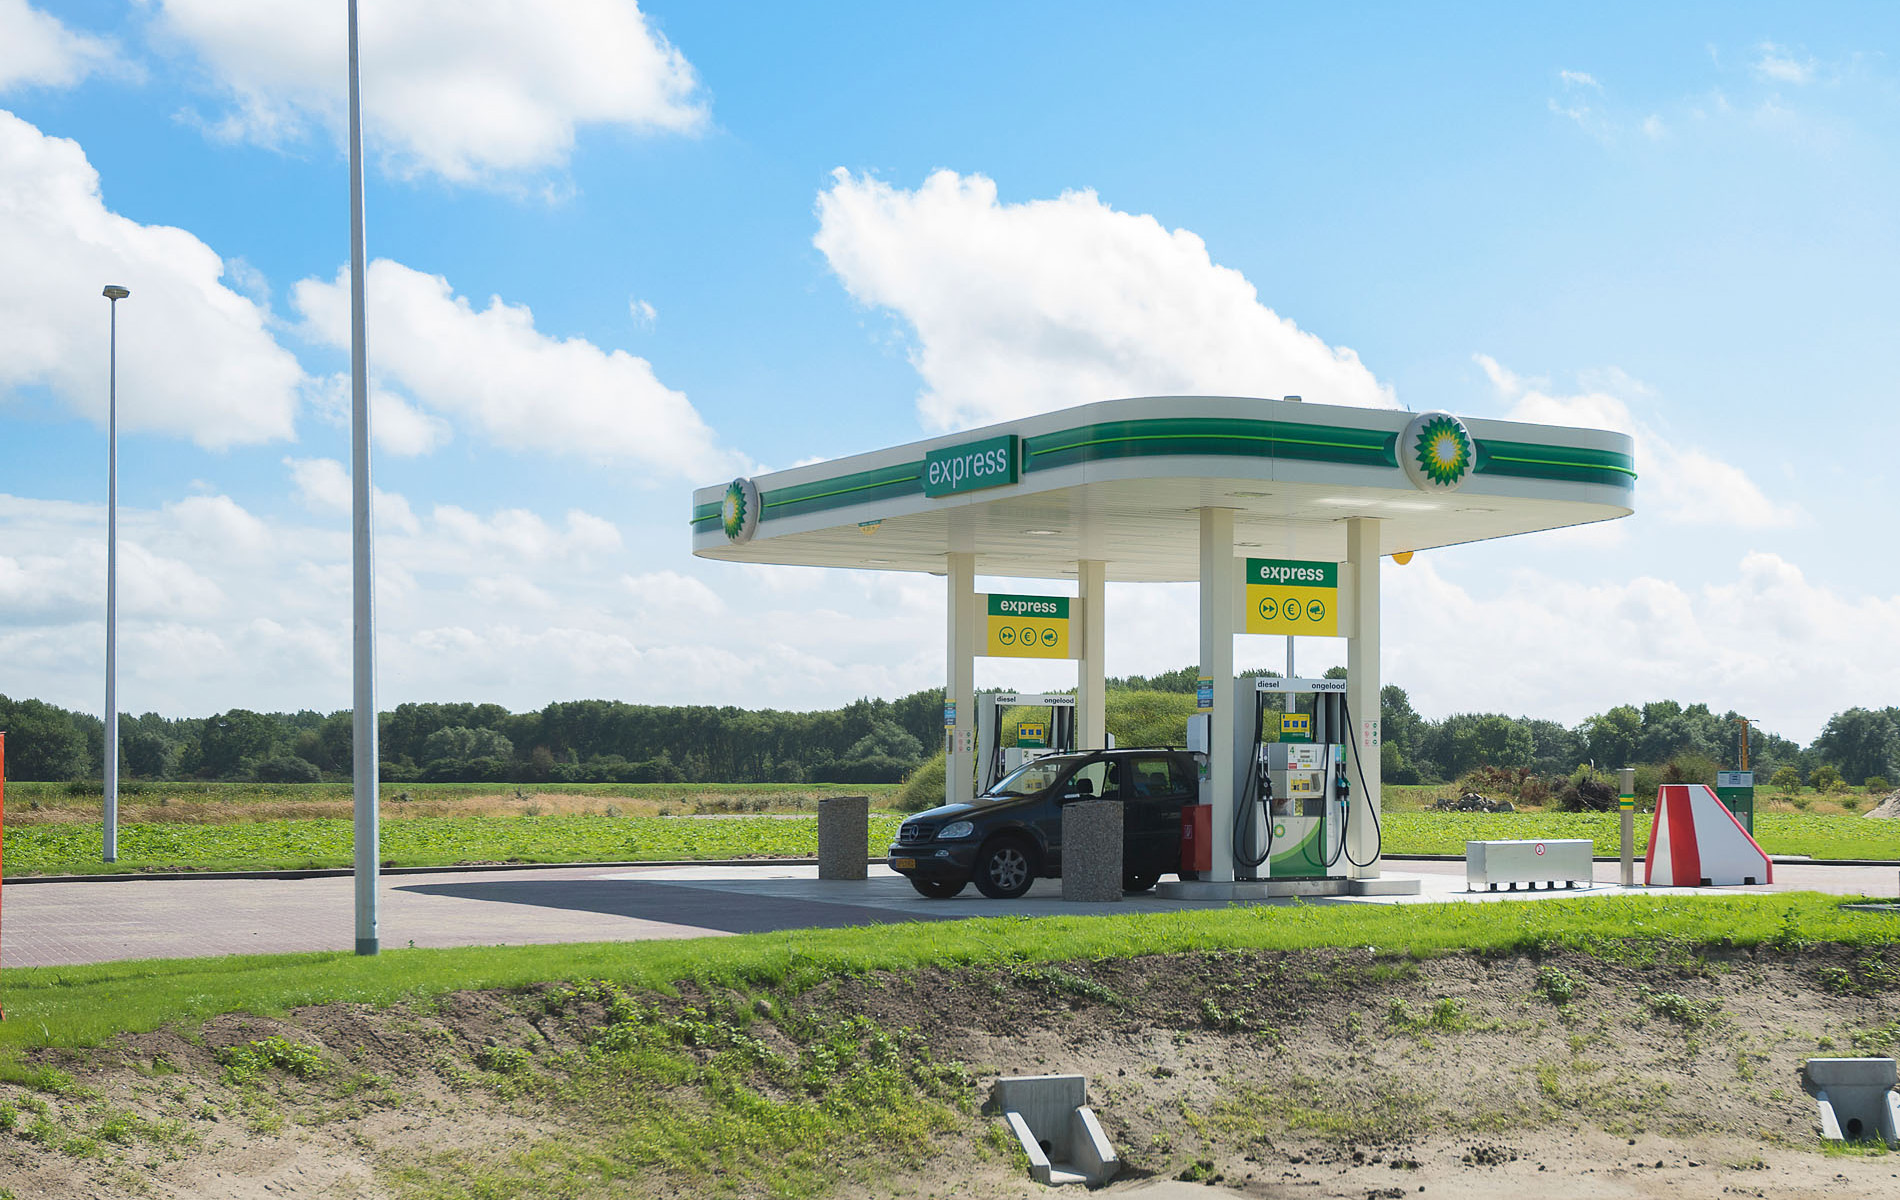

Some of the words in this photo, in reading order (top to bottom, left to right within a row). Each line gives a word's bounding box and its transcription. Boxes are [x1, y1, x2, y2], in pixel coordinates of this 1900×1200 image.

[928, 448, 1007, 489] express
[1260, 565, 1324, 583] express
[1000, 600, 1057, 614] express
[1257, 680, 1280, 689] diesel
[1311, 681, 1346, 691] ongelood
[1044, 697, 1075, 705] ongelood
[1023, 750, 1029, 758] 2
[1289, 745, 1295, 754] 4
